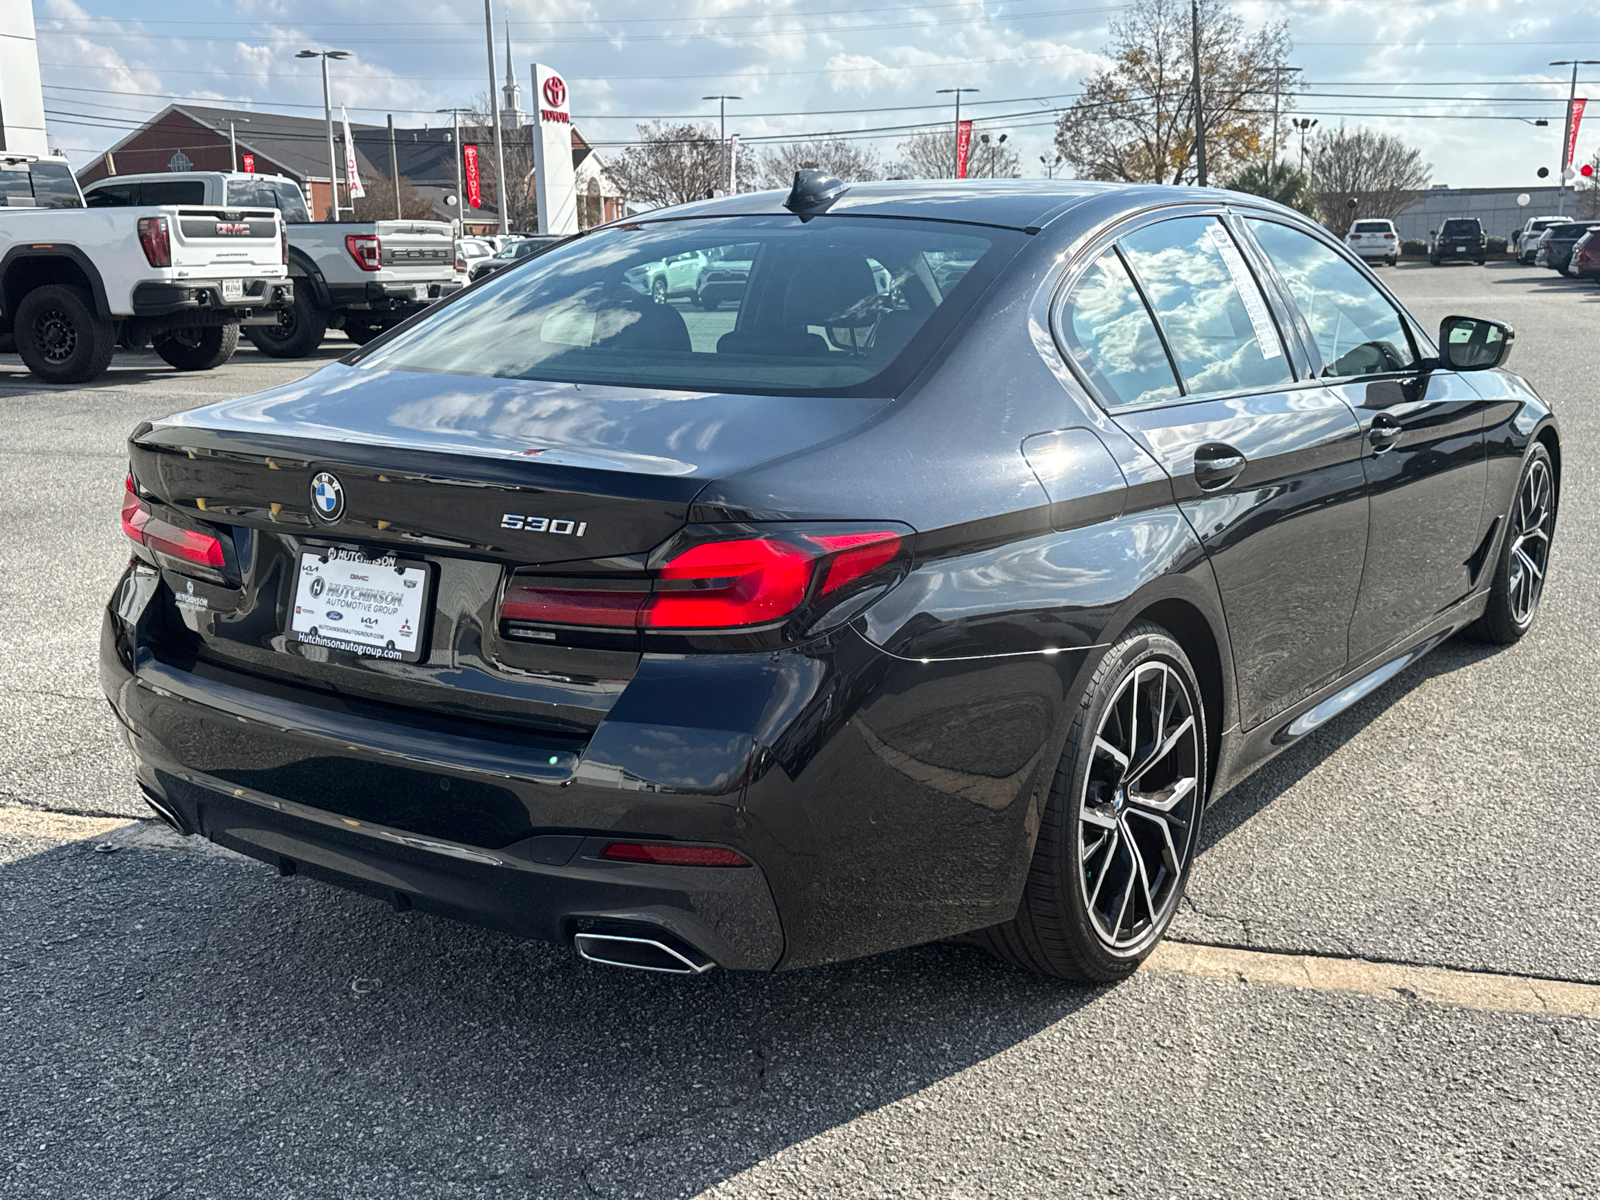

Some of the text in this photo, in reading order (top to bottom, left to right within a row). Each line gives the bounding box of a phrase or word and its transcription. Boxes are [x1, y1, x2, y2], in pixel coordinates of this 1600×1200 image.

[541, 109, 570, 124] TOYOTA
[216, 223, 251, 236] GMC
[391, 249, 448, 258] FORD
[337, 549, 396, 568] HUTCSON
[349, 573, 369, 582] GMC
[326, 582, 404, 607] HUTCHINSON
[326, 598, 399, 616] AUTOMOTIVE GROUP
[318, 624, 385, 640] HUTCHINSONAUTOGROUP.COM
[298, 632, 402, 660] Hutchinsonautogroup.com
